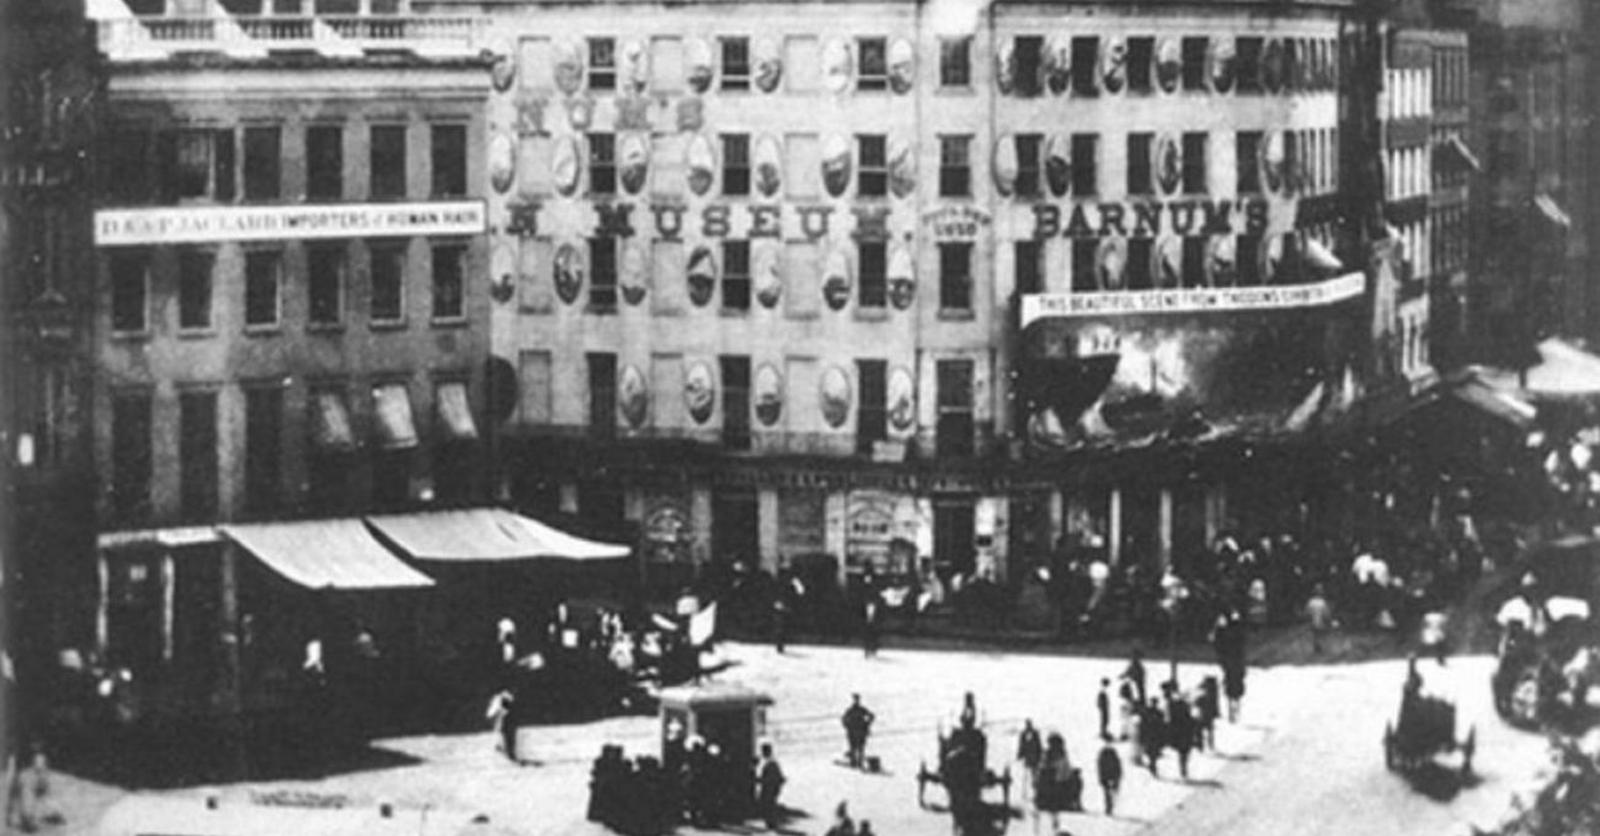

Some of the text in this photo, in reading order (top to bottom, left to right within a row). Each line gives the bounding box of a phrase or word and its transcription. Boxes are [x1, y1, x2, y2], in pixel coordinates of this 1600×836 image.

[282, 210, 369, 229] IMPORTERS
[387, 212, 438, 227] HUMAN
[443, 210, 478, 224] HAIR
[1034, 199, 1268, 239] BARNUM'S
[1039, 296, 1066, 312] THIS
[1070, 294, 1136, 311] BEAUTIFUL
[1140, 292, 1179, 308] SCENE
